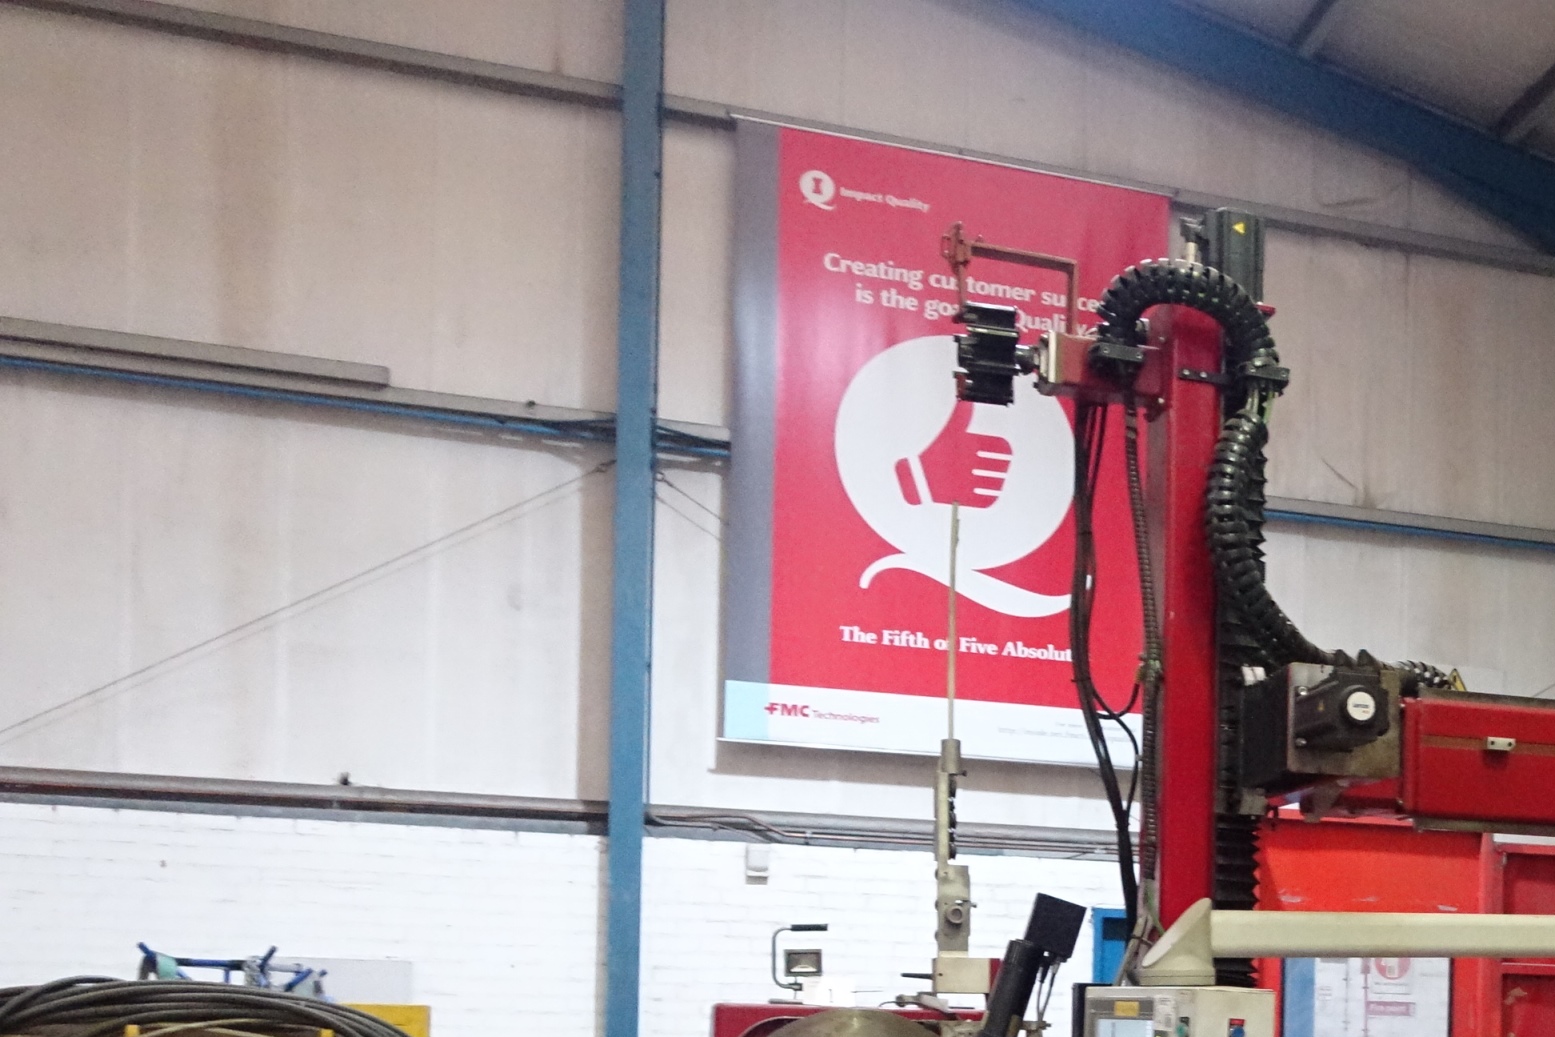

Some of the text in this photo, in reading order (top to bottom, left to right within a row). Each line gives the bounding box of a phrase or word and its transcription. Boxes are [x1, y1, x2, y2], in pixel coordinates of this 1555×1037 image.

[885, 195, 930, 213] Quality
[823, 252, 924, 290] Creating
[928, 273, 1036, 301] cutomer
[855, 283, 961, 321] is the goa
[1016, 306, 1089, 336] Qualiy
[840, 625, 877, 645] The
[881, 629, 930, 650] Fifth
[959, 636, 998, 656] Five
[1001, 641, 1073, 662] Absolut
[764, 702, 880, 724] FMC Technologies
